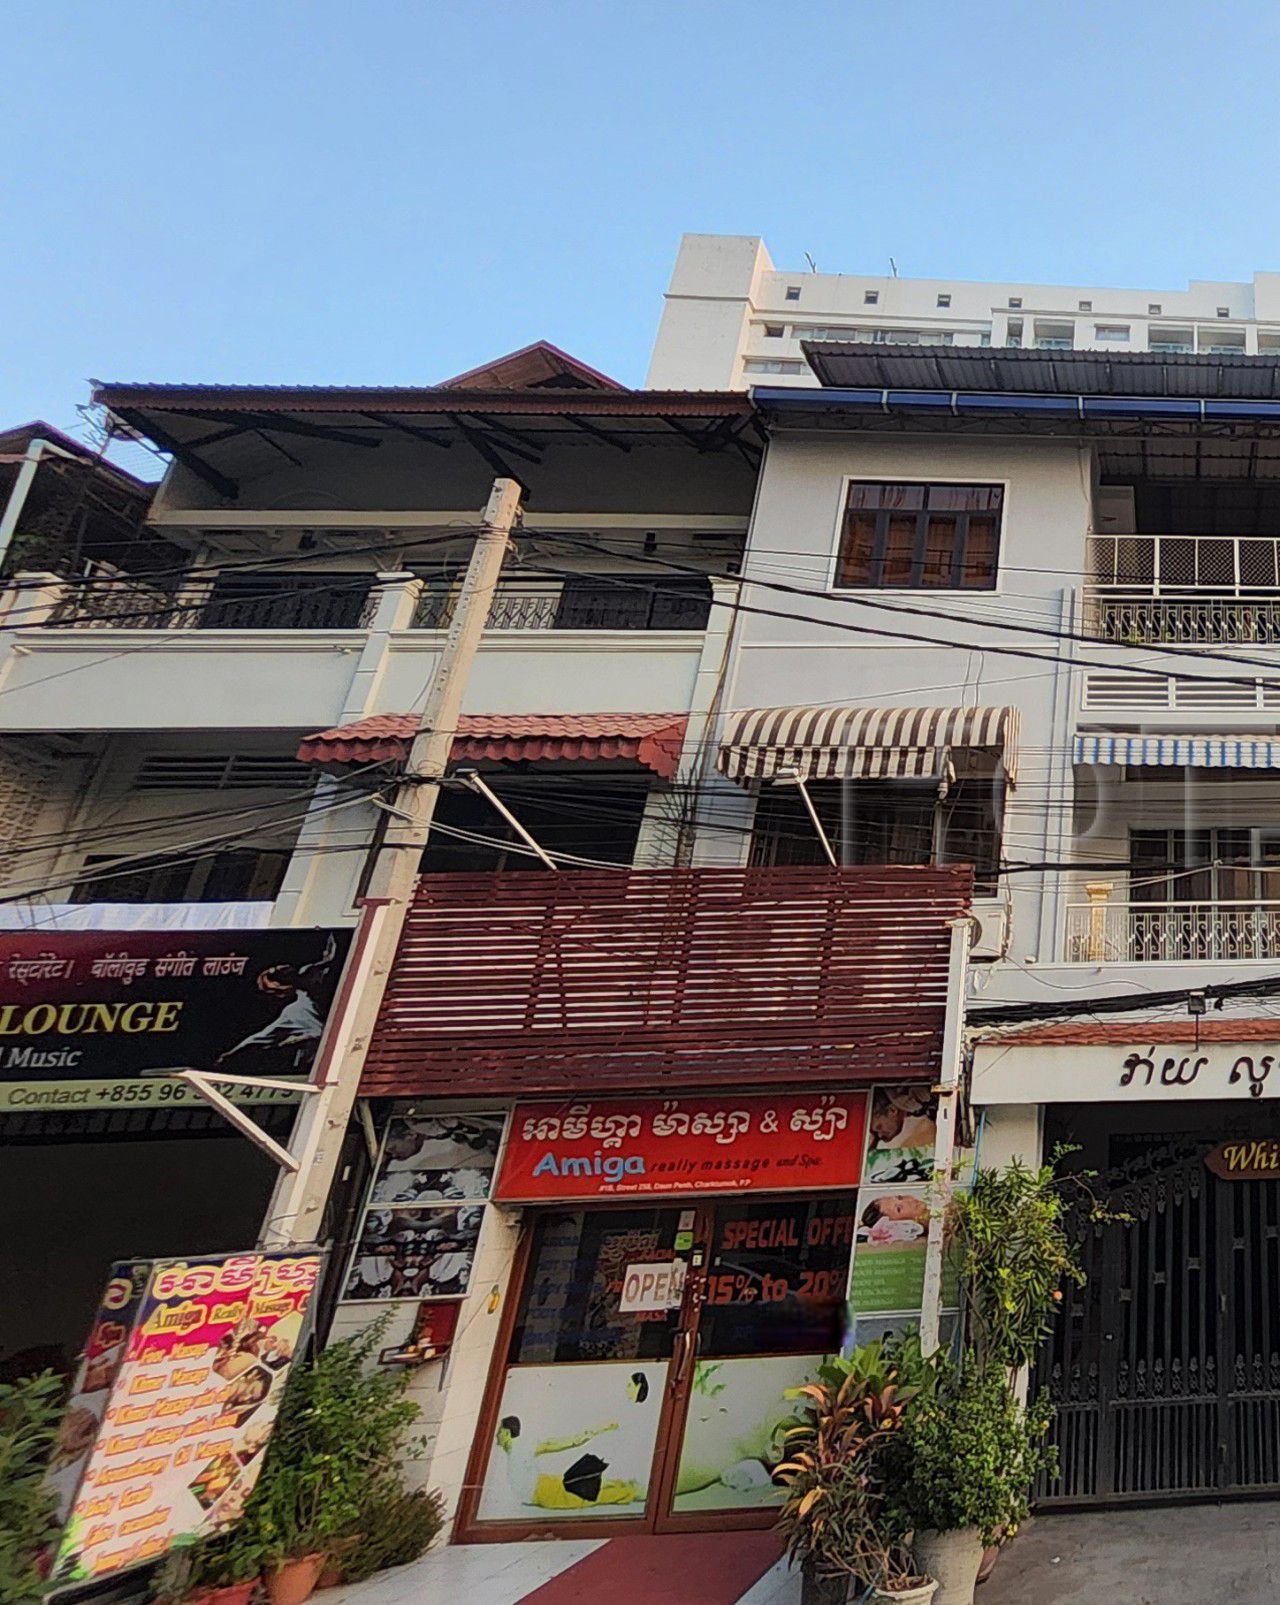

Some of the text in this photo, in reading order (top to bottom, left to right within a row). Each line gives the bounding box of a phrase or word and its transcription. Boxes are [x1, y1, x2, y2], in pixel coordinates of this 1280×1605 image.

[0, 1002, 183, 1035] LOUNGE
[4, 1047, 83, 1068] Music
[8, 1088, 90, 1105] Contact
[96, 1084, 152, 1102] +855
[158, 1083, 187, 1101] 96
[759, 1110, 779, 1133] &
[532, 1150, 646, 1183] Amiga
[650, 1159, 698, 1175] really
[701, 1157, 771, 1172] massage
[722, 1217, 799, 1249] SPECIAL
[707, 1274, 756, 1304] 15%
[761, 1273, 788, 1301] to
